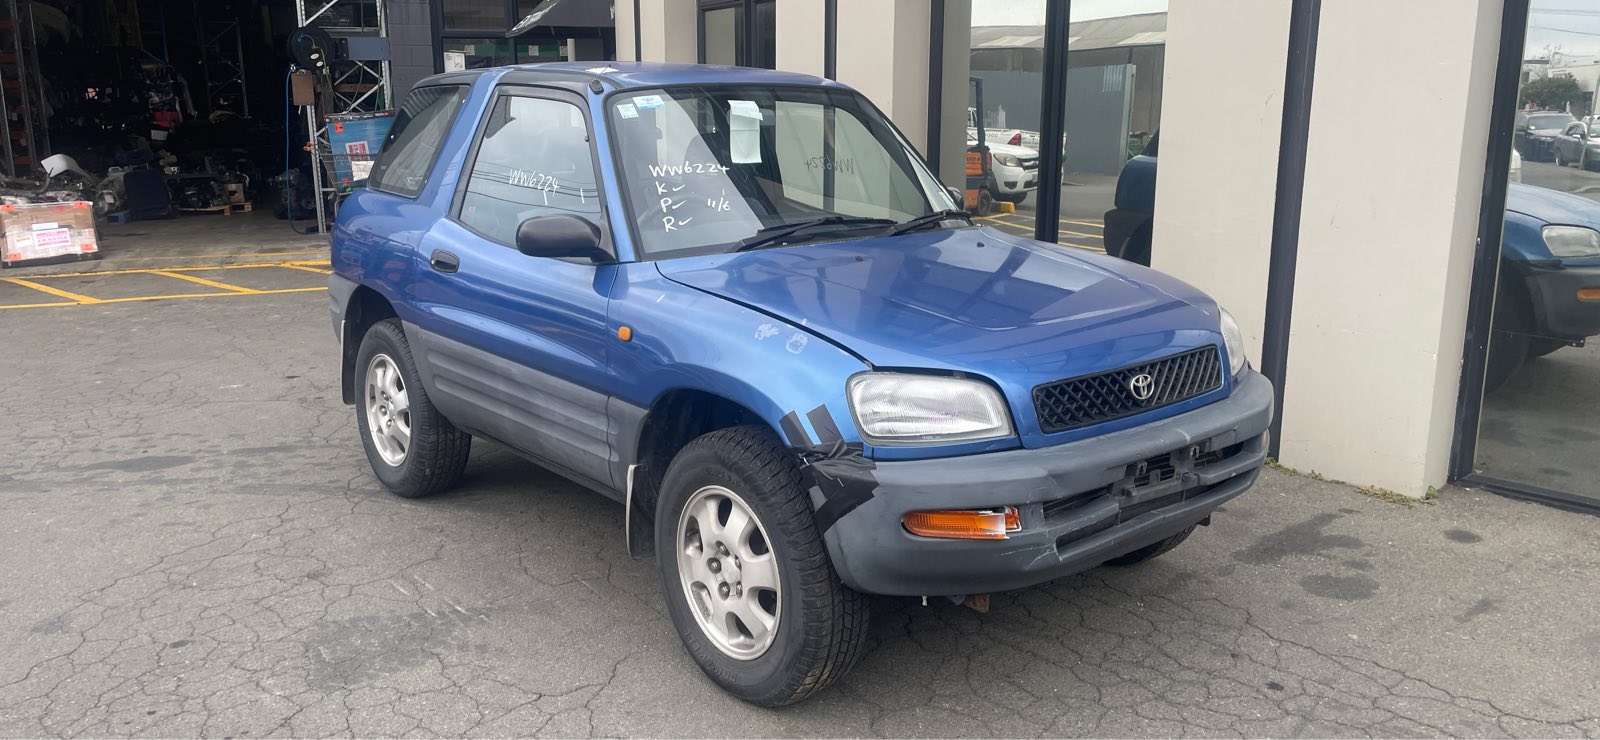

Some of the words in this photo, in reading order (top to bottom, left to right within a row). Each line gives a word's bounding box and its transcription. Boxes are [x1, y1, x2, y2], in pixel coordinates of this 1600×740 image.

[648, 160, 730, 177] WW6224
[509, 168, 560, 197] WW6224
[655, 181, 668, 195] K
[660, 197, 672, 212] P
[662, 216, 678, 232] R
